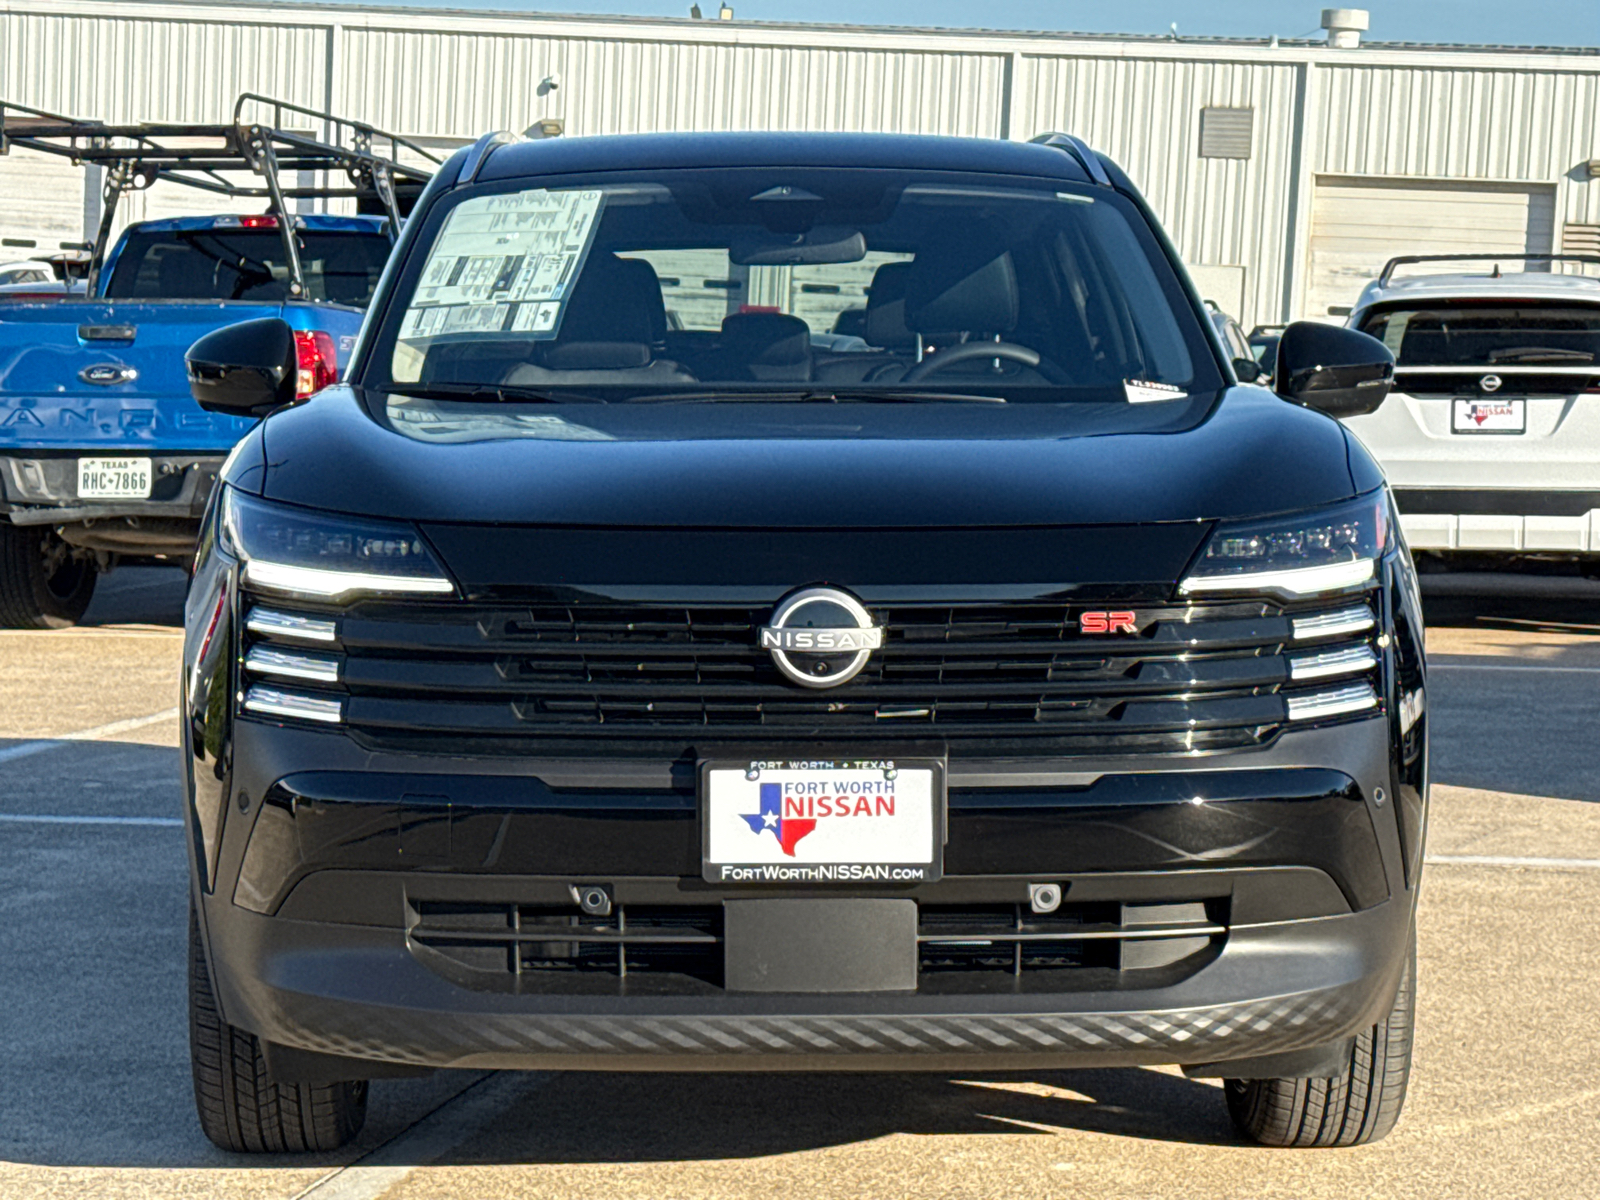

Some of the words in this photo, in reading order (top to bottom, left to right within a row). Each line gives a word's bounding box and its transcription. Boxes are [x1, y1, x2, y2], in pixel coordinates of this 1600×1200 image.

[101, 460, 129, 469] TEXAS
[1080, 610, 1138, 635] SR
[762, 630, 879, 649] NISSAN
[751, 761, 783, 770] FORT
[789, 761, 834, 770] WORTH
[854, 761, 895, 770] TEXAS
[784, 781, 829, 795] FORT
[833, 780, 895, 794] WORTH
[784, 796, 895, 818] NISSAN
